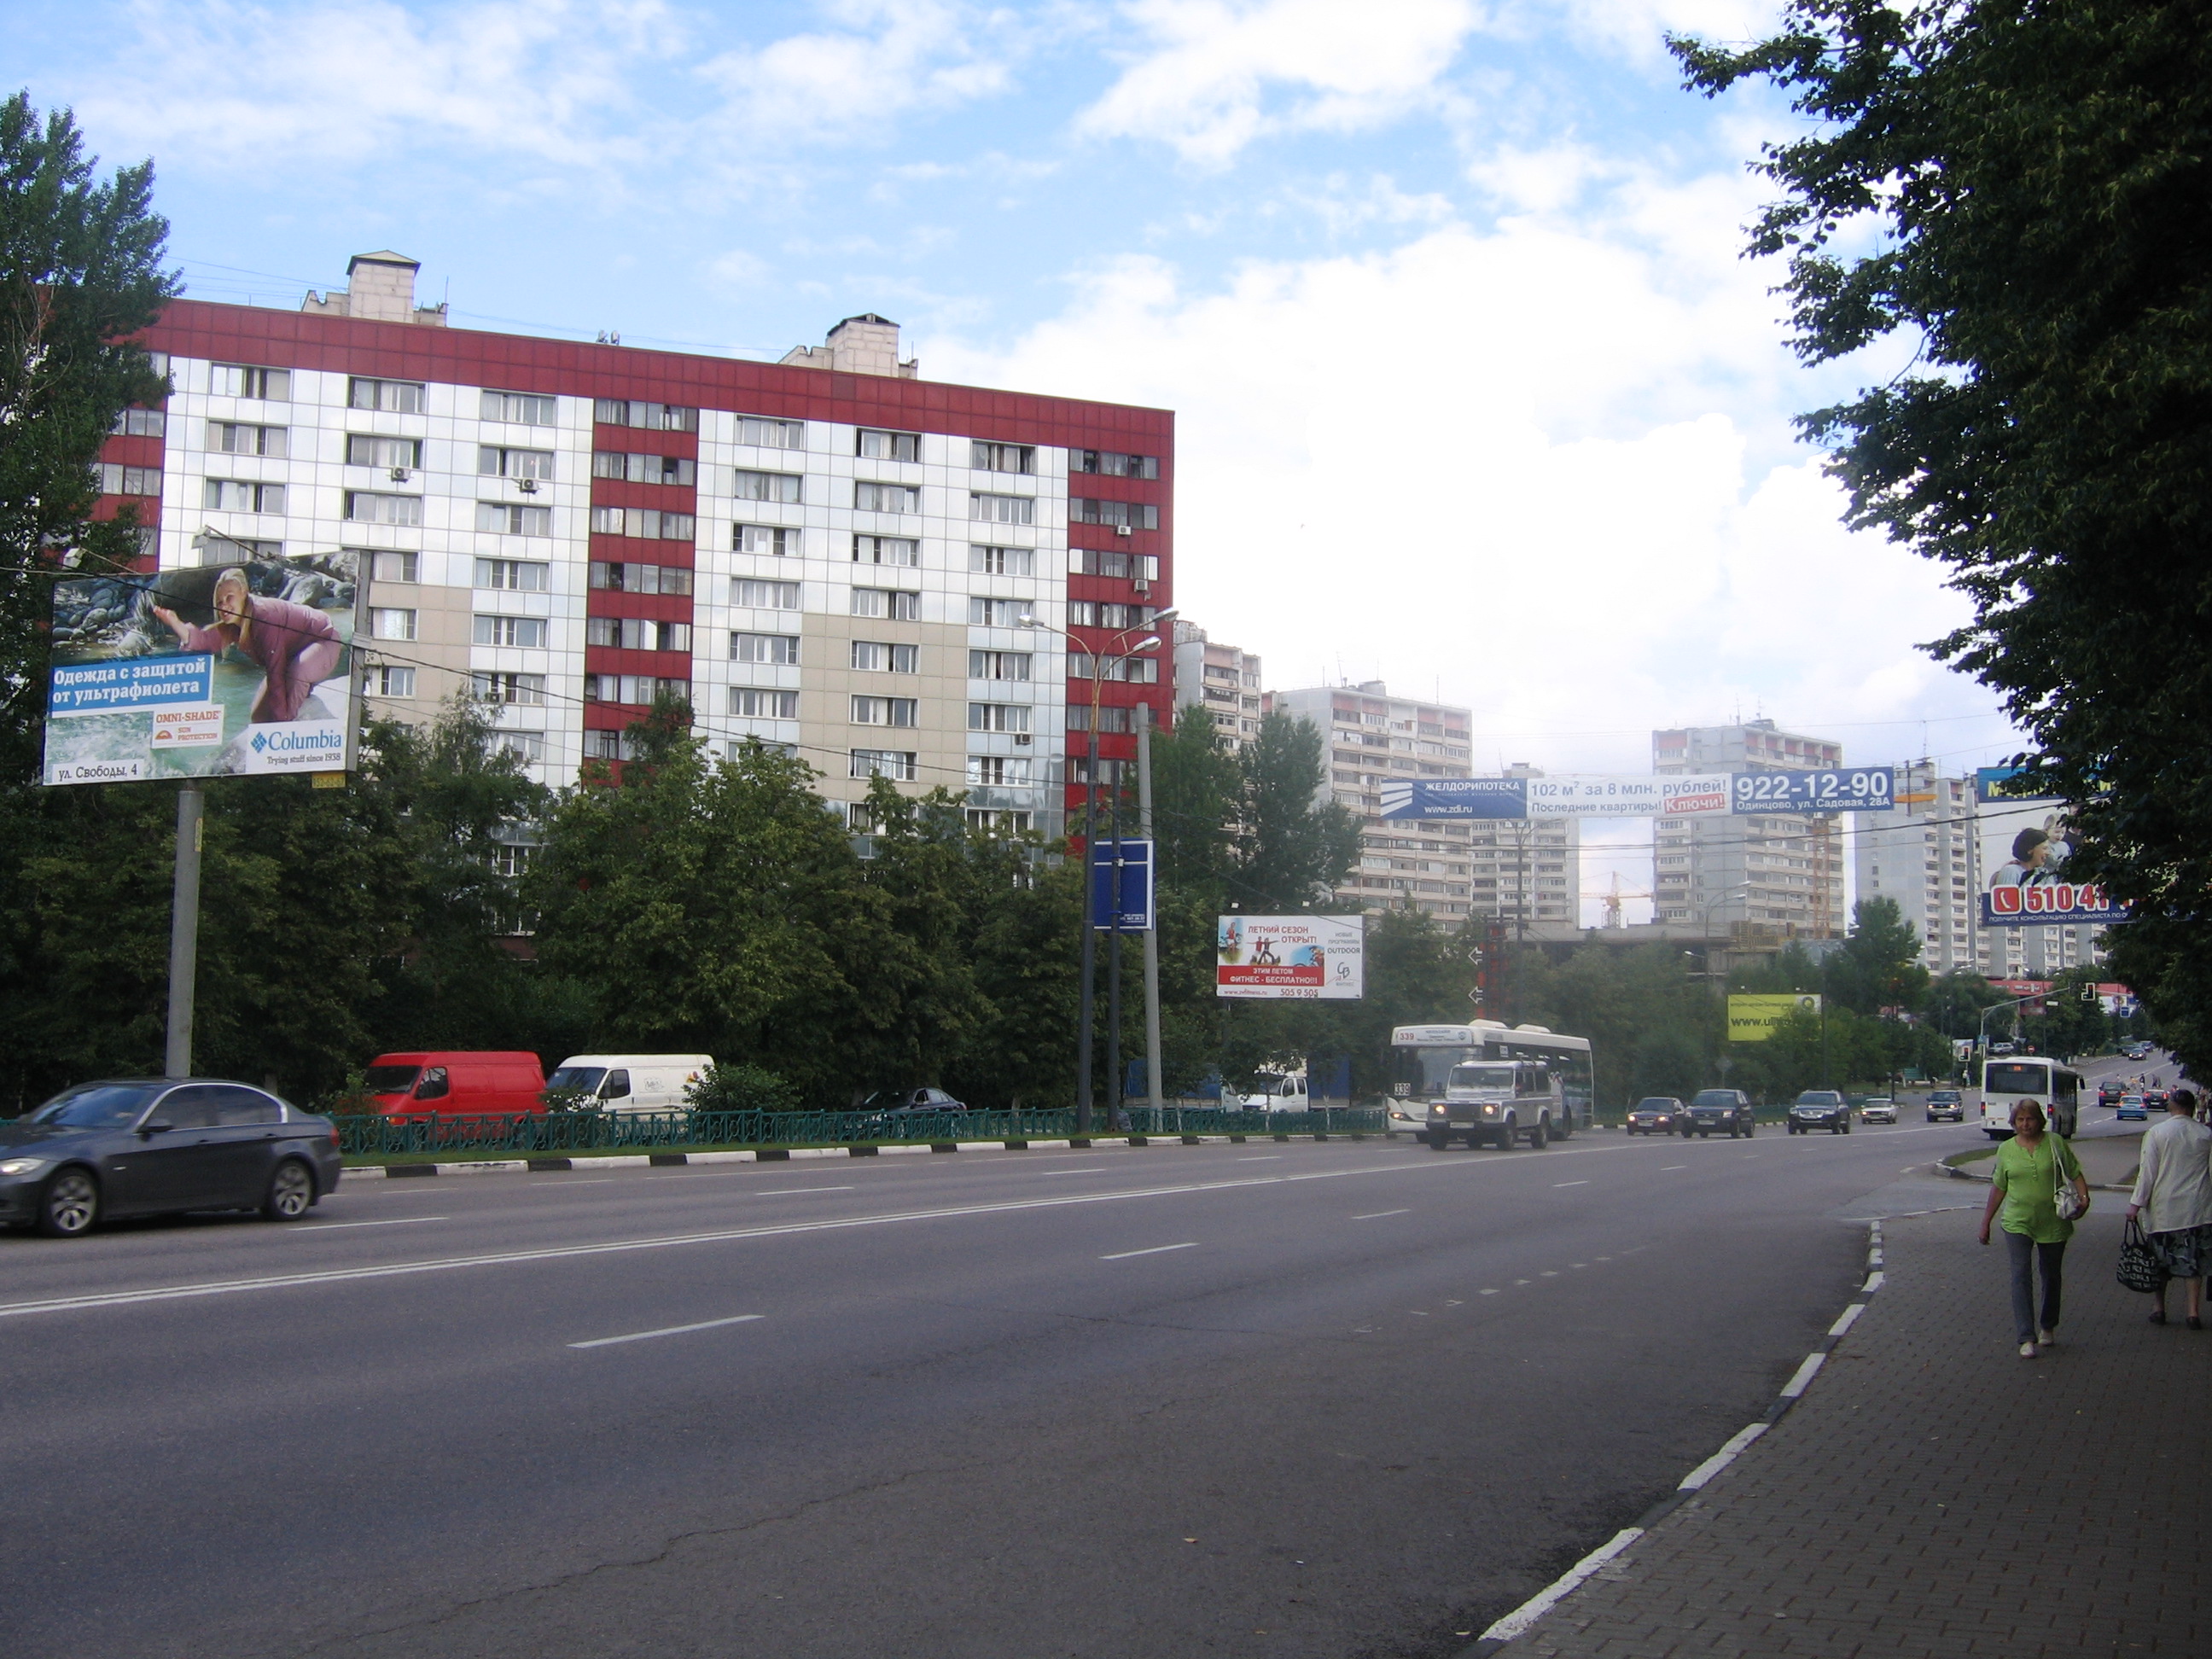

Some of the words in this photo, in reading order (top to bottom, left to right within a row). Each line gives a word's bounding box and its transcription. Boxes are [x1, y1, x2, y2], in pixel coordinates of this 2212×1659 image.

[54, 668, 116, 686] Одежда
[119, 668, 129, 679] с
[132, 657, 206, 679] защитой
[53, 690, 71, 703] от
[74, 681, 200, 707] ультрафиолета
[268, 729, 342, 751] Columbia
[267, 756, 288, 766] Trying
[290, 754, 306, 764] stuff
[324, 753, 341, 761] 1938
[59, 770, 72, 782] ул.
[76, 765, 128, 778] Свободы,
[131, 764, 137, 775] 4
[1425, 782, 1520, 792] ЖЕЛДОРИПОТЕКА
[1532, 784, 1557, 796] 102
[1585, 785, 1603, 795] за
[1608, 783, 1616, 795] 8
[1621, 784, 1657, 795] млн.
[1662, 779, 1726, 796] рублей!
[1737, 771, 1888, 800] 922-12-90
[1532, 802, 1597, 812] Последние
[1600, 800, 1662, 812] квартиры!
[1666, 795, 1724, 812] Ключи!
[1737, 801, 1794, 812] Одинцово,
[1797, 800, 1813, 810] ул.
[1816, 798, 1866, 809] Садовая,
[2026, 885, 2074, 911] 510
[1249, 924, 1279, 934] ЛЕТНИЙ
[1303, 989, 1318, 998] 505
[1395, 1083, 1411, 1095] 339
